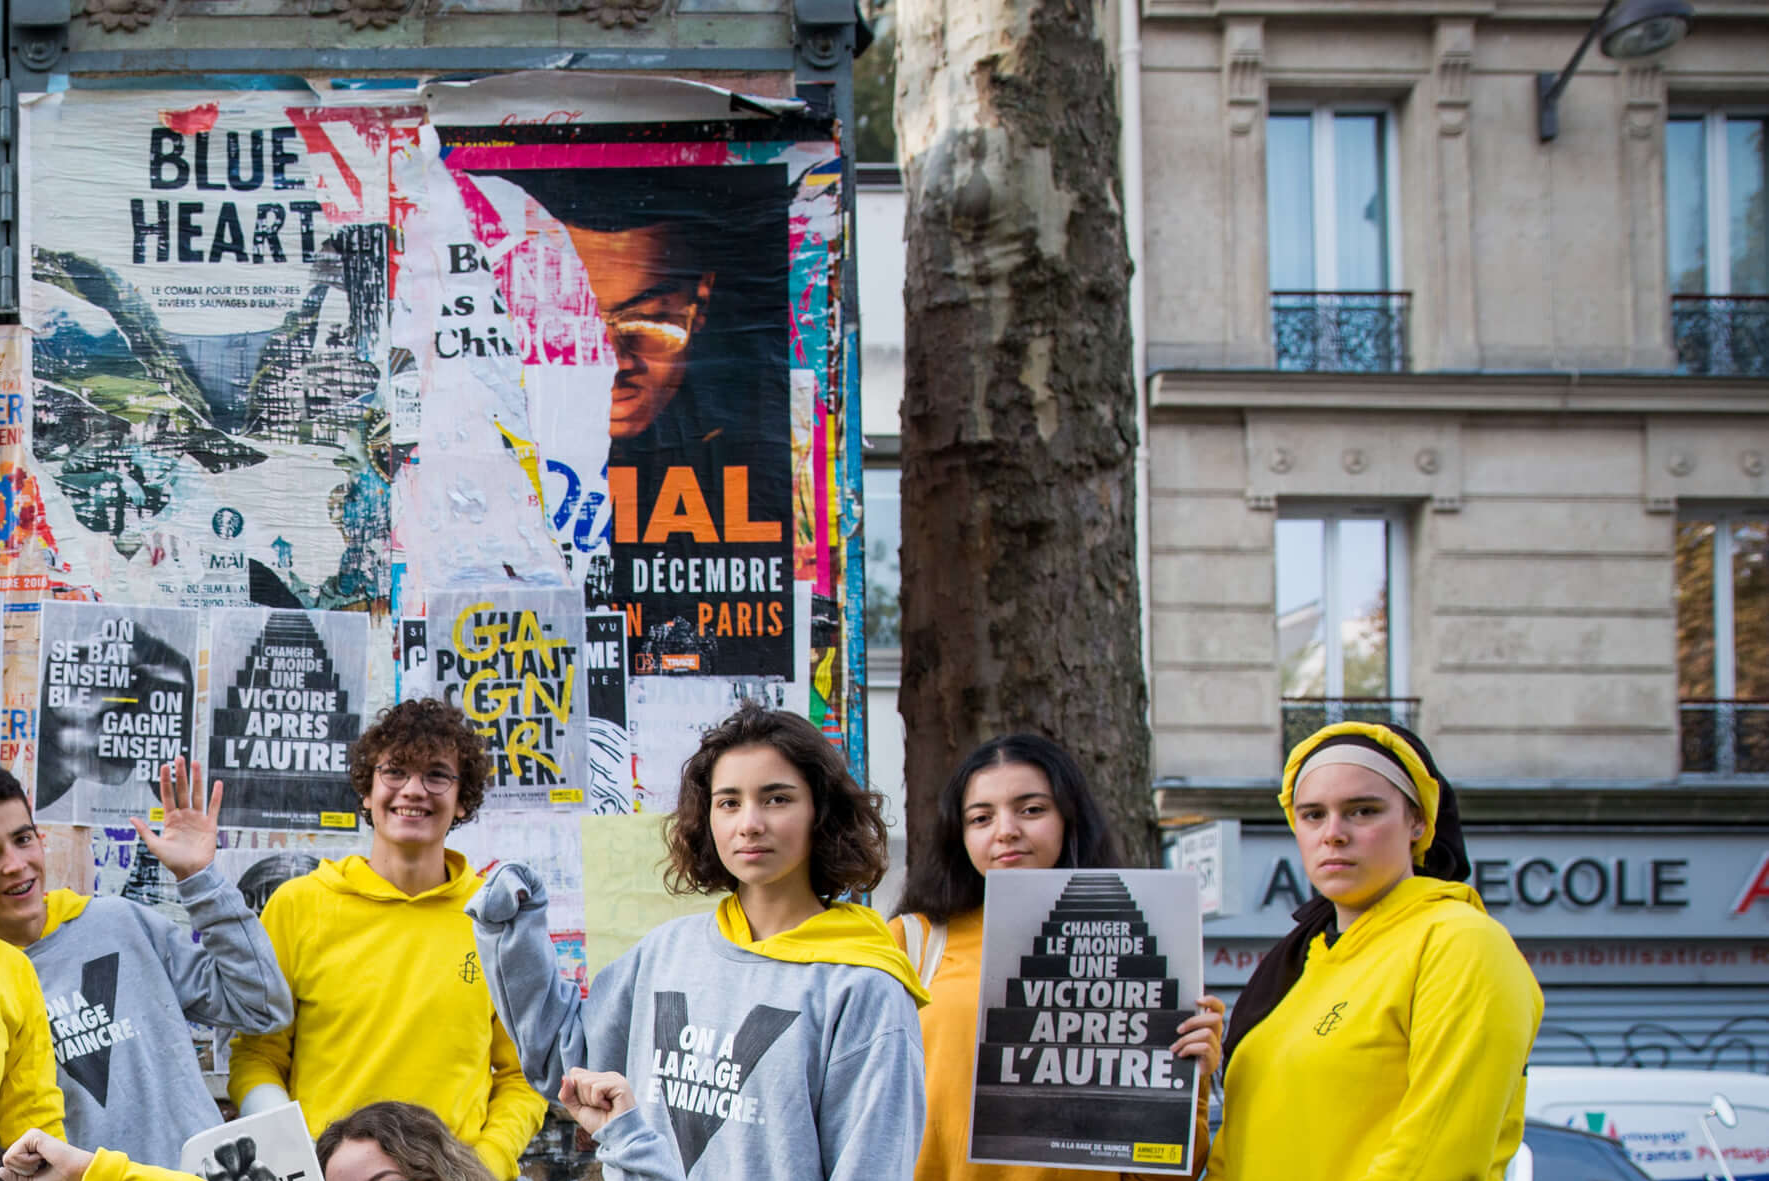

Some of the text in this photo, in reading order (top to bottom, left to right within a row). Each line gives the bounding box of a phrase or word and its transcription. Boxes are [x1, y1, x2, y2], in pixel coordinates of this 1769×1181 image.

[149, 126, 306, 192] BLUE
[131, 198, 322, 265] HEART
[632, 551, 783, 593] DÉCEMBRE
[101, 618, 134, 643] ON
[697, 602, 783, 638] PARIS
[51, 641, 133, 665] SE BAT
[254, 656, 324, 673] LE MONDE
[264, 645, 315, 659] CHANGER
[49, 663, 138, 689] ENSEM-
[269, 671, 306, 689] UNE
[48, 686, 92, 709] BLE
[149, 690, 182, 713] ON
[238, 688, 338, 712] VICTOIRE
[101, 711, 182, 736] GAGNE
[245, 708, 329, 739] APRÈS
[98, 734, 188, 760] ENSEM-
[225, 740, 351, 772] L'AUTRE.
[1474, 858, 1690, 907] ECOLE
[1061, 921, 1131, 937] CHANGER
[1046, 937, 1144, 956] LE MONDE
[1069, 956, 1118, 978] UNE
[1022, 980, 1163, 1009] VICTOIRE
[58, 1003, 111, 1040] RAGE
[1029, 1010, 1148, 1045] APRÈS
[679, 1024, 735, 1060] ON A
[652, 1049, 742, 1092] LA RAGE
[1000, 1047, 1185, 1090] L'AUTRE.
[666, 1080, 766, 1125] VAINCRE.
